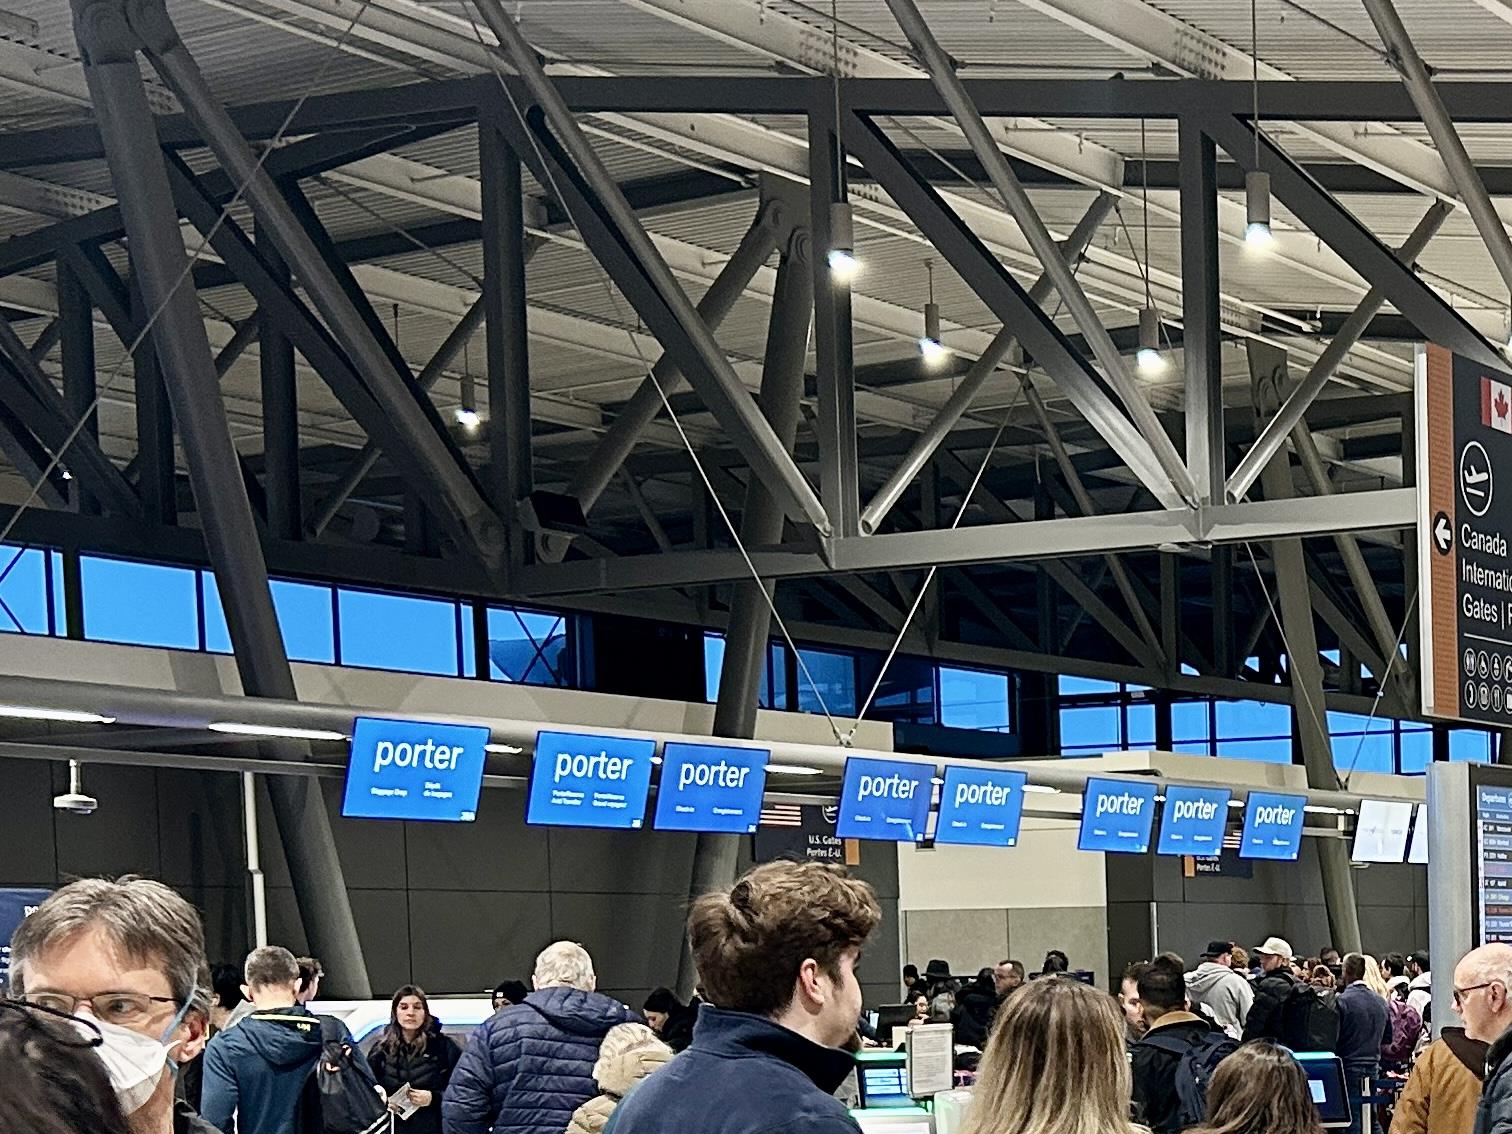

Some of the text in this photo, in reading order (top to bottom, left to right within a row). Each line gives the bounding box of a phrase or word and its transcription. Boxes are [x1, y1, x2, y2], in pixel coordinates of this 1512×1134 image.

[1461, 523, 1507, 557] Canada
[1463, 593, 1498, 623] Gates
[373, 738, 464, 773] porter
[554, 750, 633, 783] porter
[679, 760, 750, 791] porter
[858, 773, 919, 801] porter
[955, 781, 1011, 808] porter
[1096, 792, 1146, 817] porter
[1173, 798, 1219, 823] porter
[1254, 804, 1296, 828] porter
